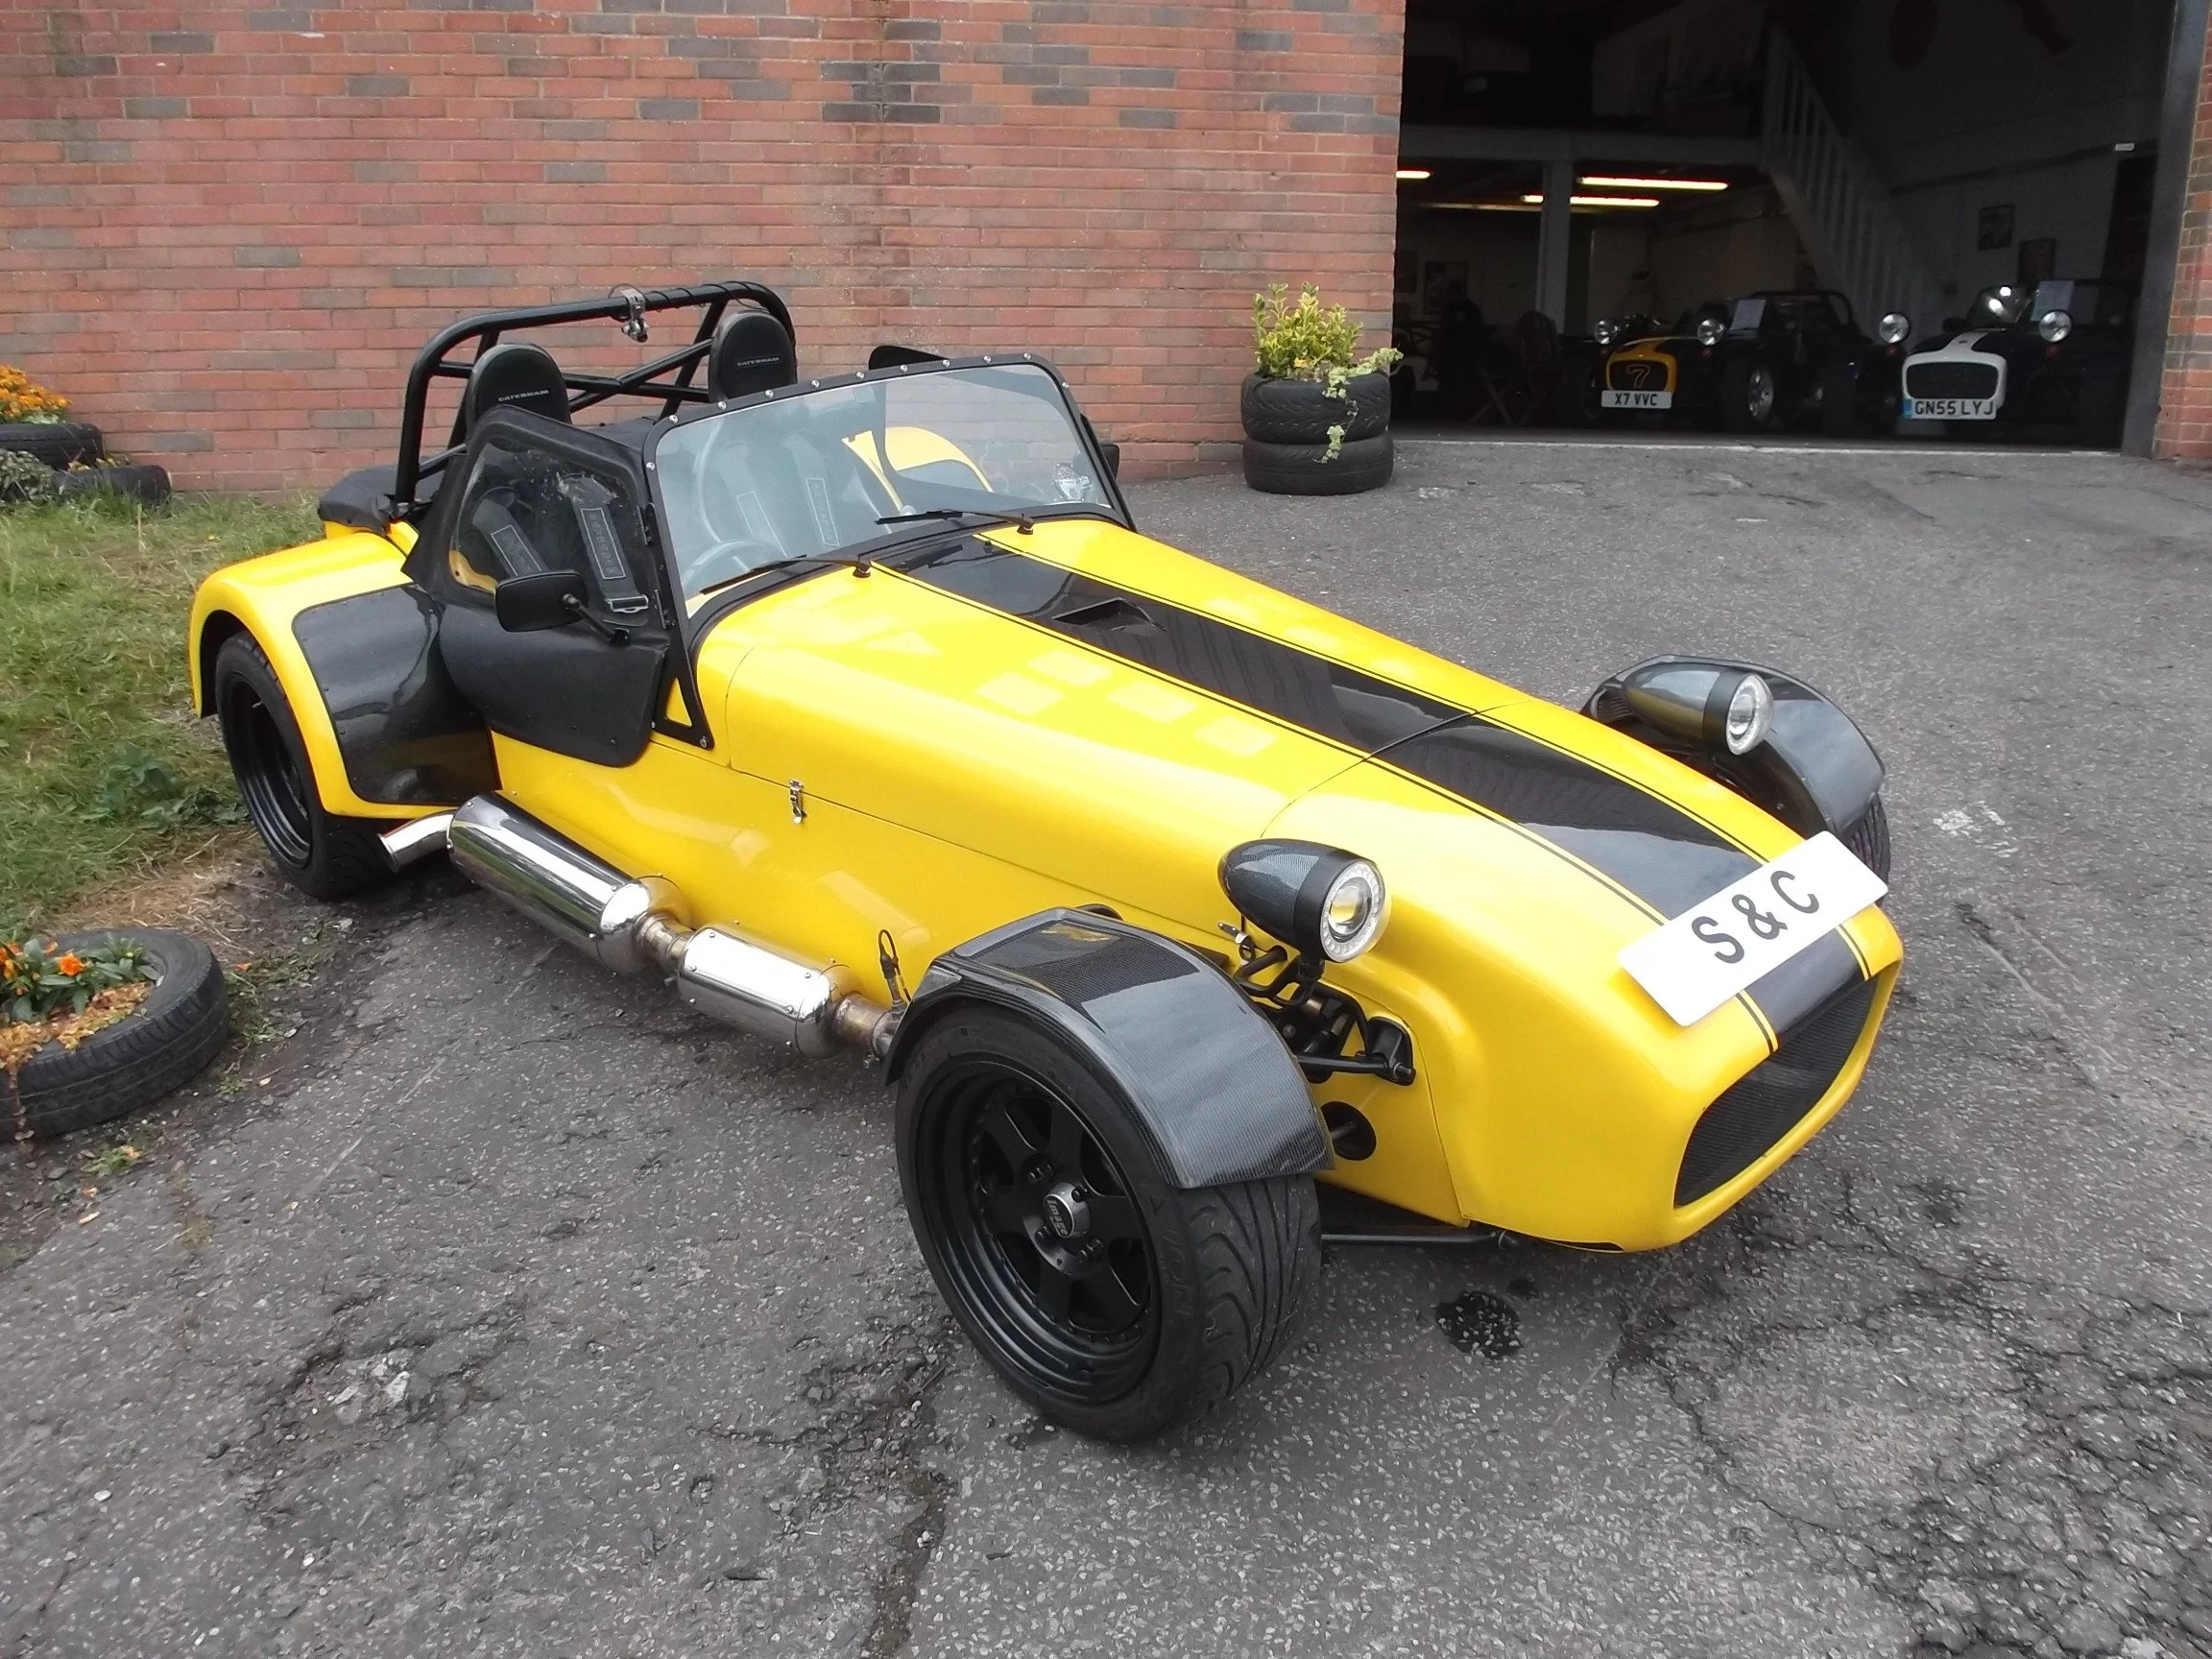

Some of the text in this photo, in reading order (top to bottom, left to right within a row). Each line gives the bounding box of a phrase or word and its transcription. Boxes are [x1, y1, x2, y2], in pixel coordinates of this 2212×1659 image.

[1626, 364, 1651, 389] 7
[1615, 393, 1630, 405] X7
[1914, 400, 1994, 415] GN55 LYJ
